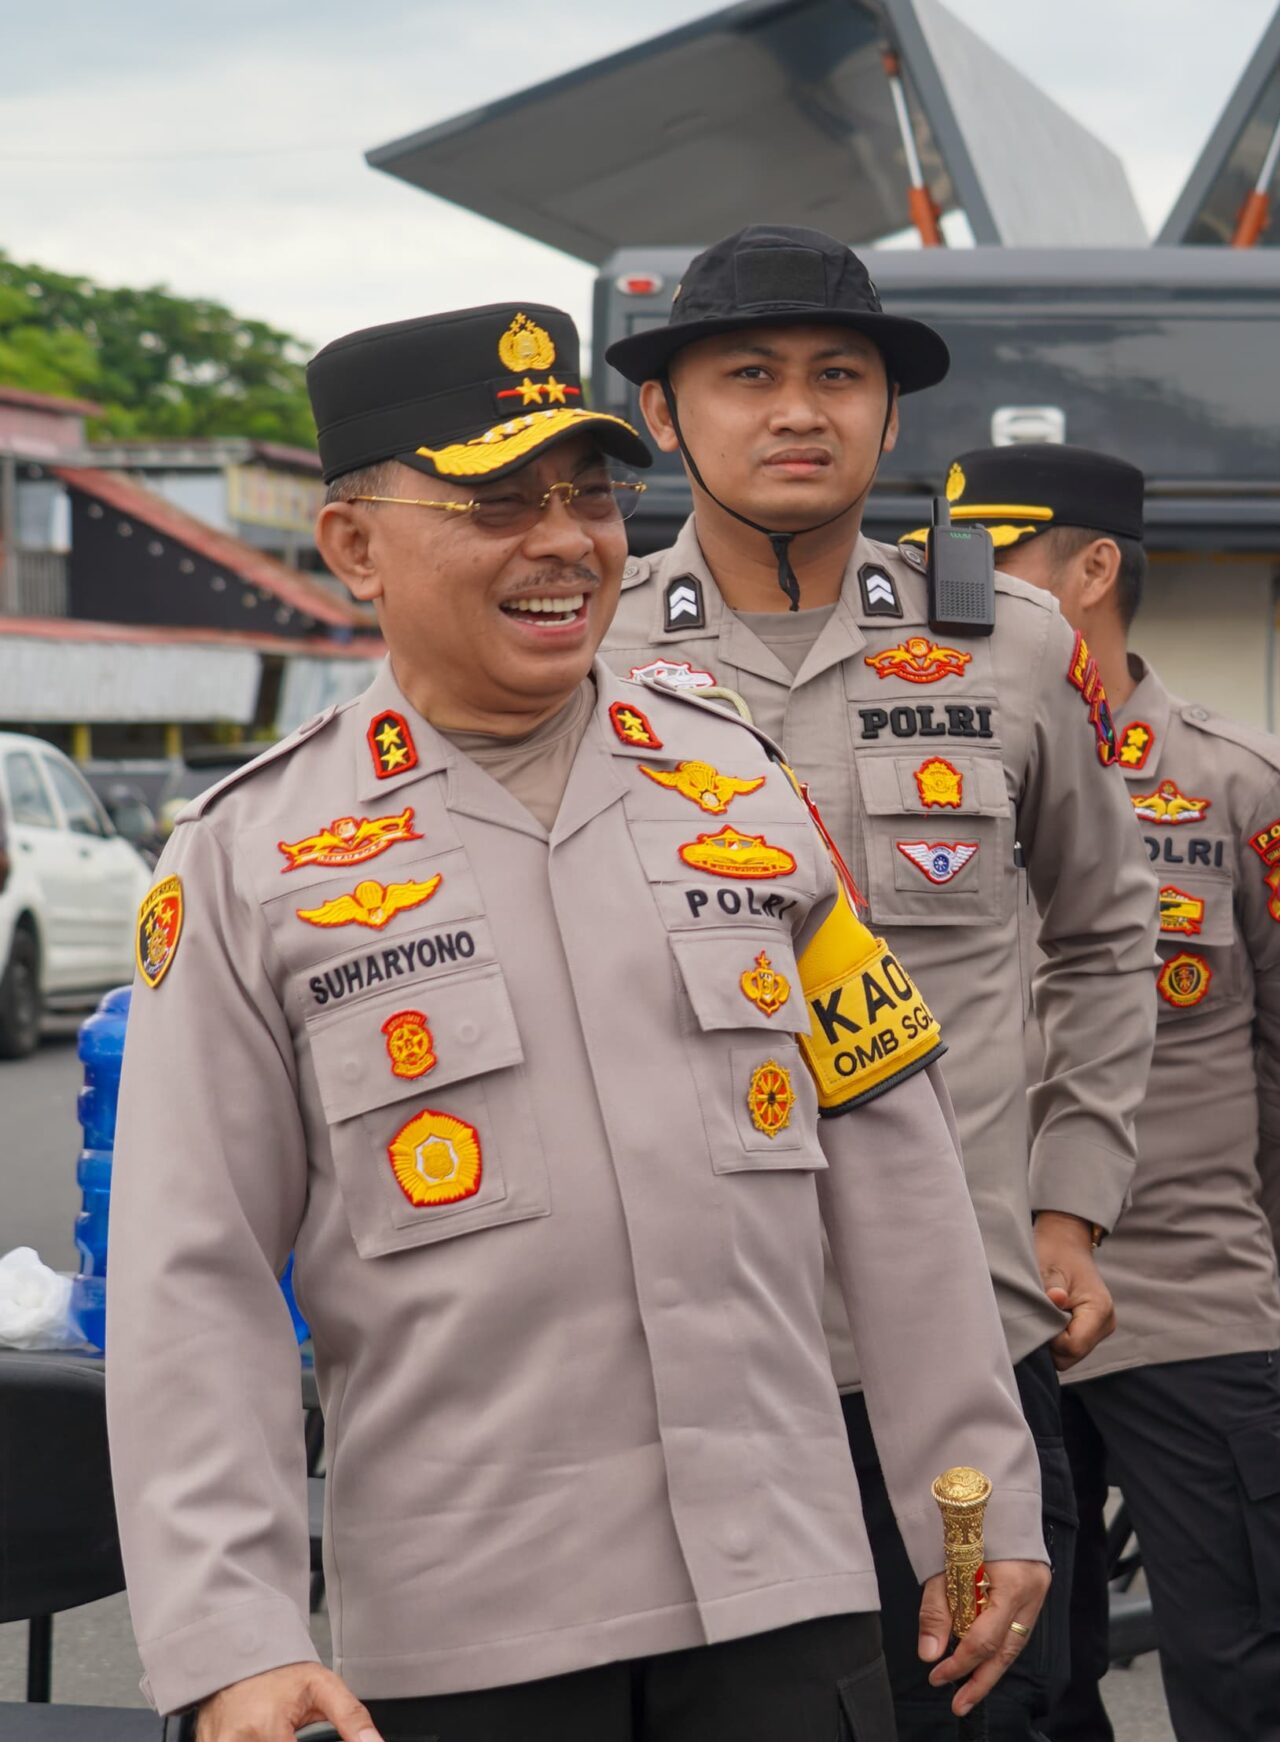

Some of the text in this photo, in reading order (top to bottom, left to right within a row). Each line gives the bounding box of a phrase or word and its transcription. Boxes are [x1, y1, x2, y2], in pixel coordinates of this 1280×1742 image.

[858, 704, 993, 739] POLRI
[1143, 836, 1224, 867] OLRI
[309, 930, 475, 1004] SUHARYONO
[811, 955, 914, 1046] KAO
[834, 1028, 899, 1077] OMB
